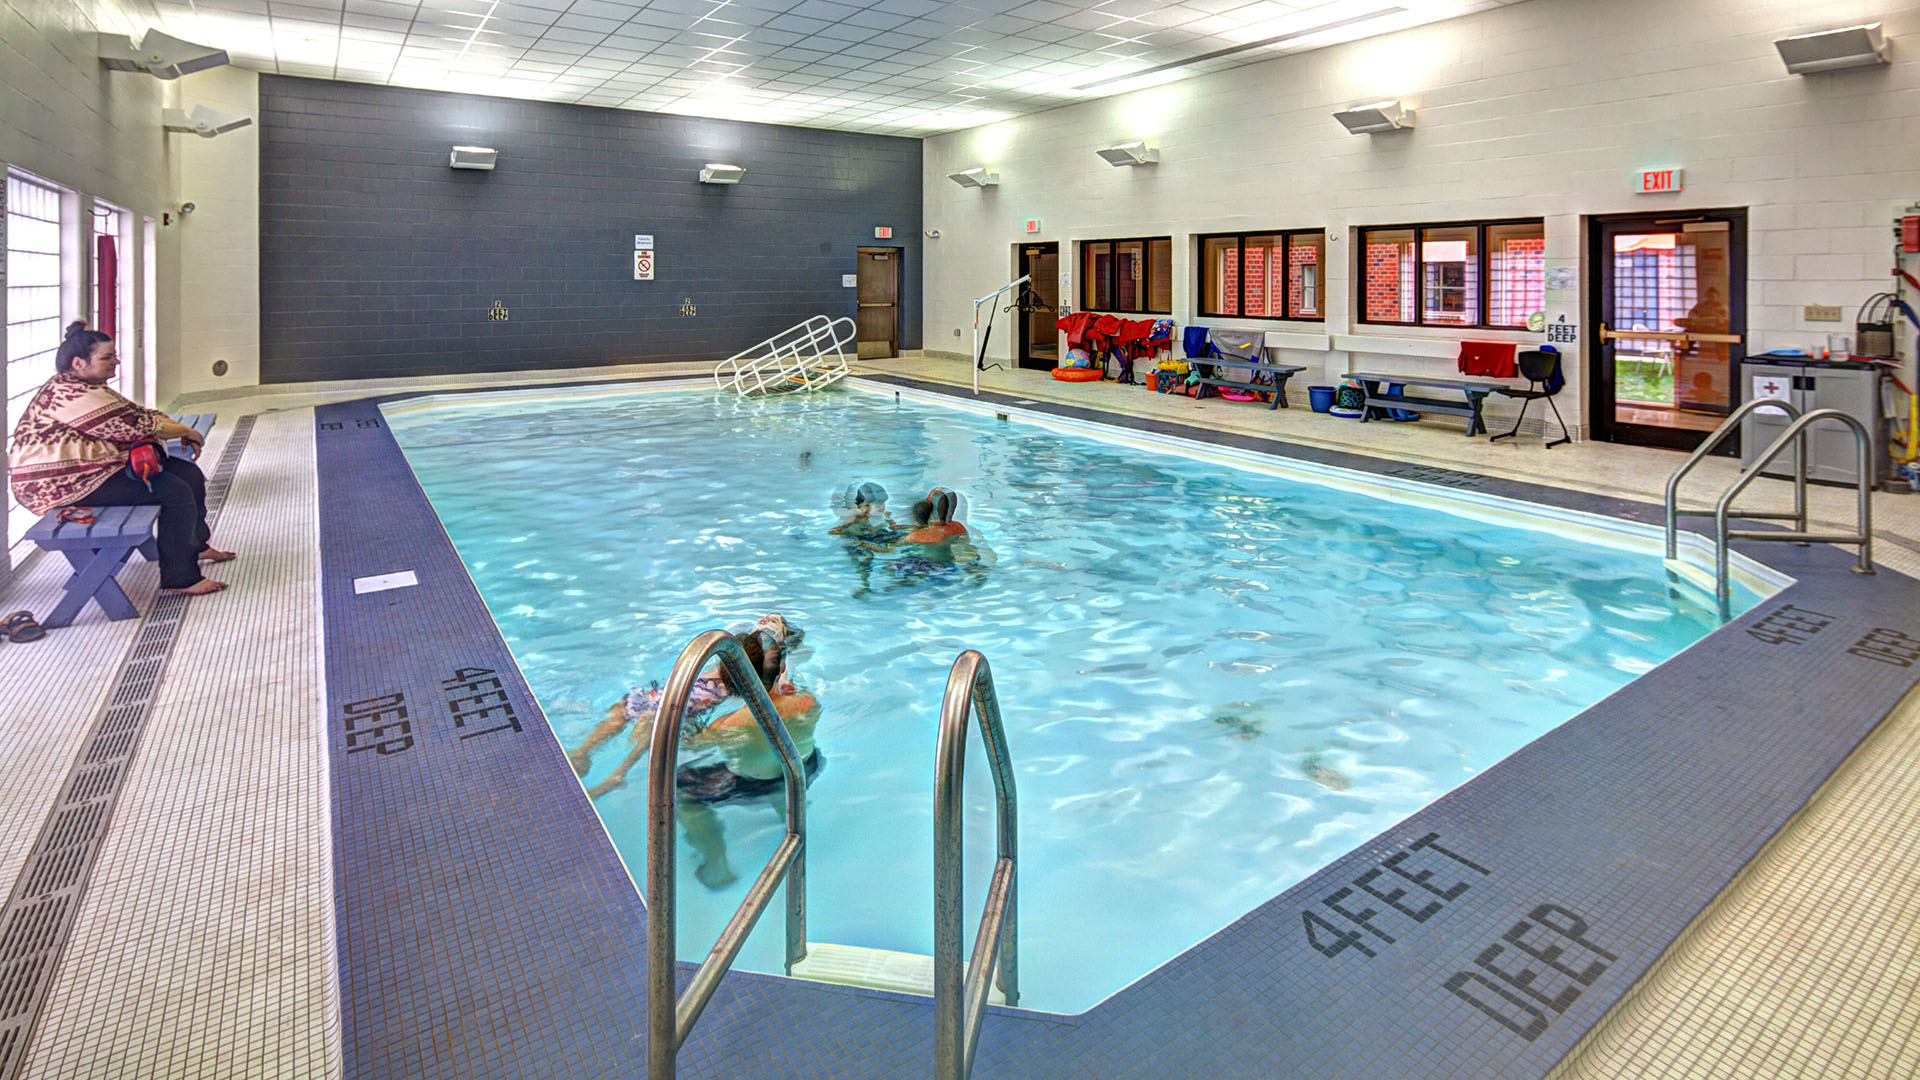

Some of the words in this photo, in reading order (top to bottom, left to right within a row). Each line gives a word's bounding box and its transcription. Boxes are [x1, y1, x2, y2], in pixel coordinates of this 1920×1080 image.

[1643, 170, 1674, 191] EXIT
[1547, 324, 1577, 334] FEET
[1558, 314, 1565, 323] 4
[1547, 333, 1576, 342] DEEP
[1846, 628, 1920, 667] DEEP
[343, 692, 414, 755] DEEP
[1443, 903, 1618, 1042] DEEP
